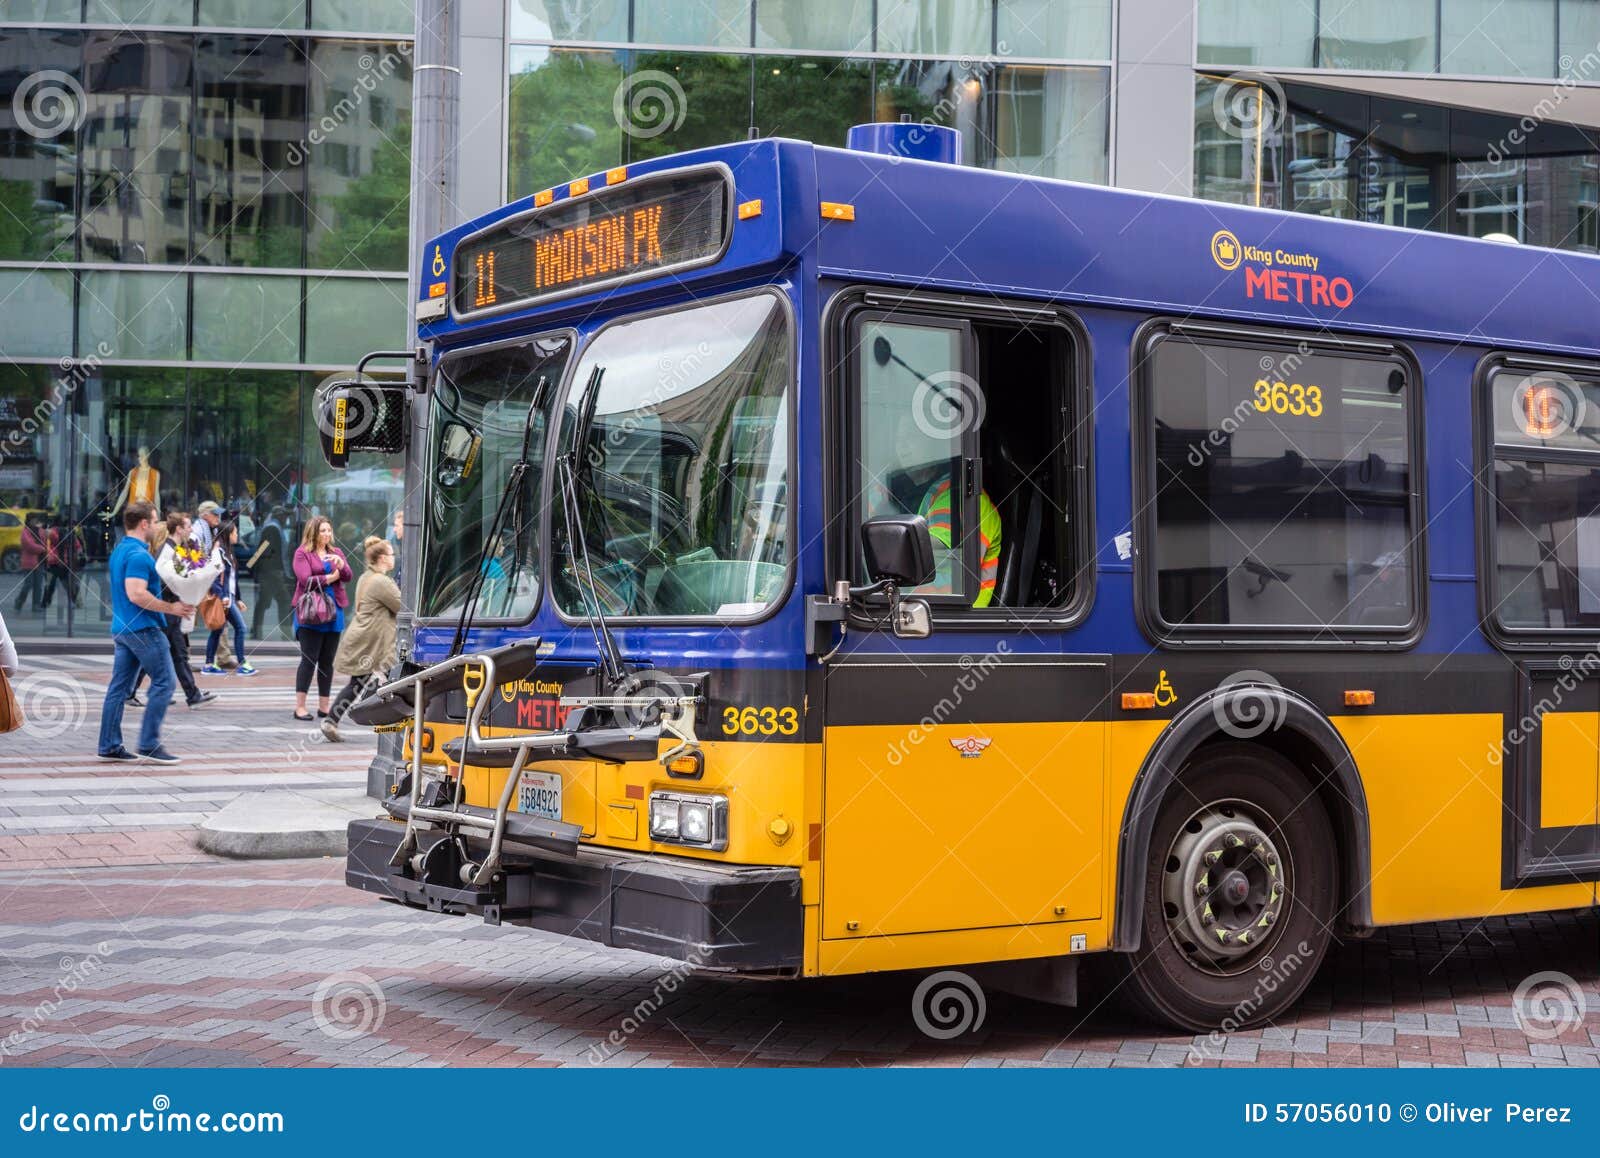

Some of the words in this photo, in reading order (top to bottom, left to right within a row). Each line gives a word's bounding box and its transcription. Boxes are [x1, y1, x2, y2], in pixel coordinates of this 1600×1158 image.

[475, 251, 496, 306] 11
[535, 216, 625, 288] MADISON
[633, 205, 662, 265] PK
[1244, 246, 1272, 266] King
[1275, 249, 1318, 271] County
[1245, 266, 1354, 308] METRO
[1254, 379, 1323, 417] 3633
[518, 679, 535, 696] King
[536, 680, 563, 697] County
[517, 698, 580, 729] METR
[722, 706, 799, 735] 3633
[525, 787, 559, 813] 68492C
